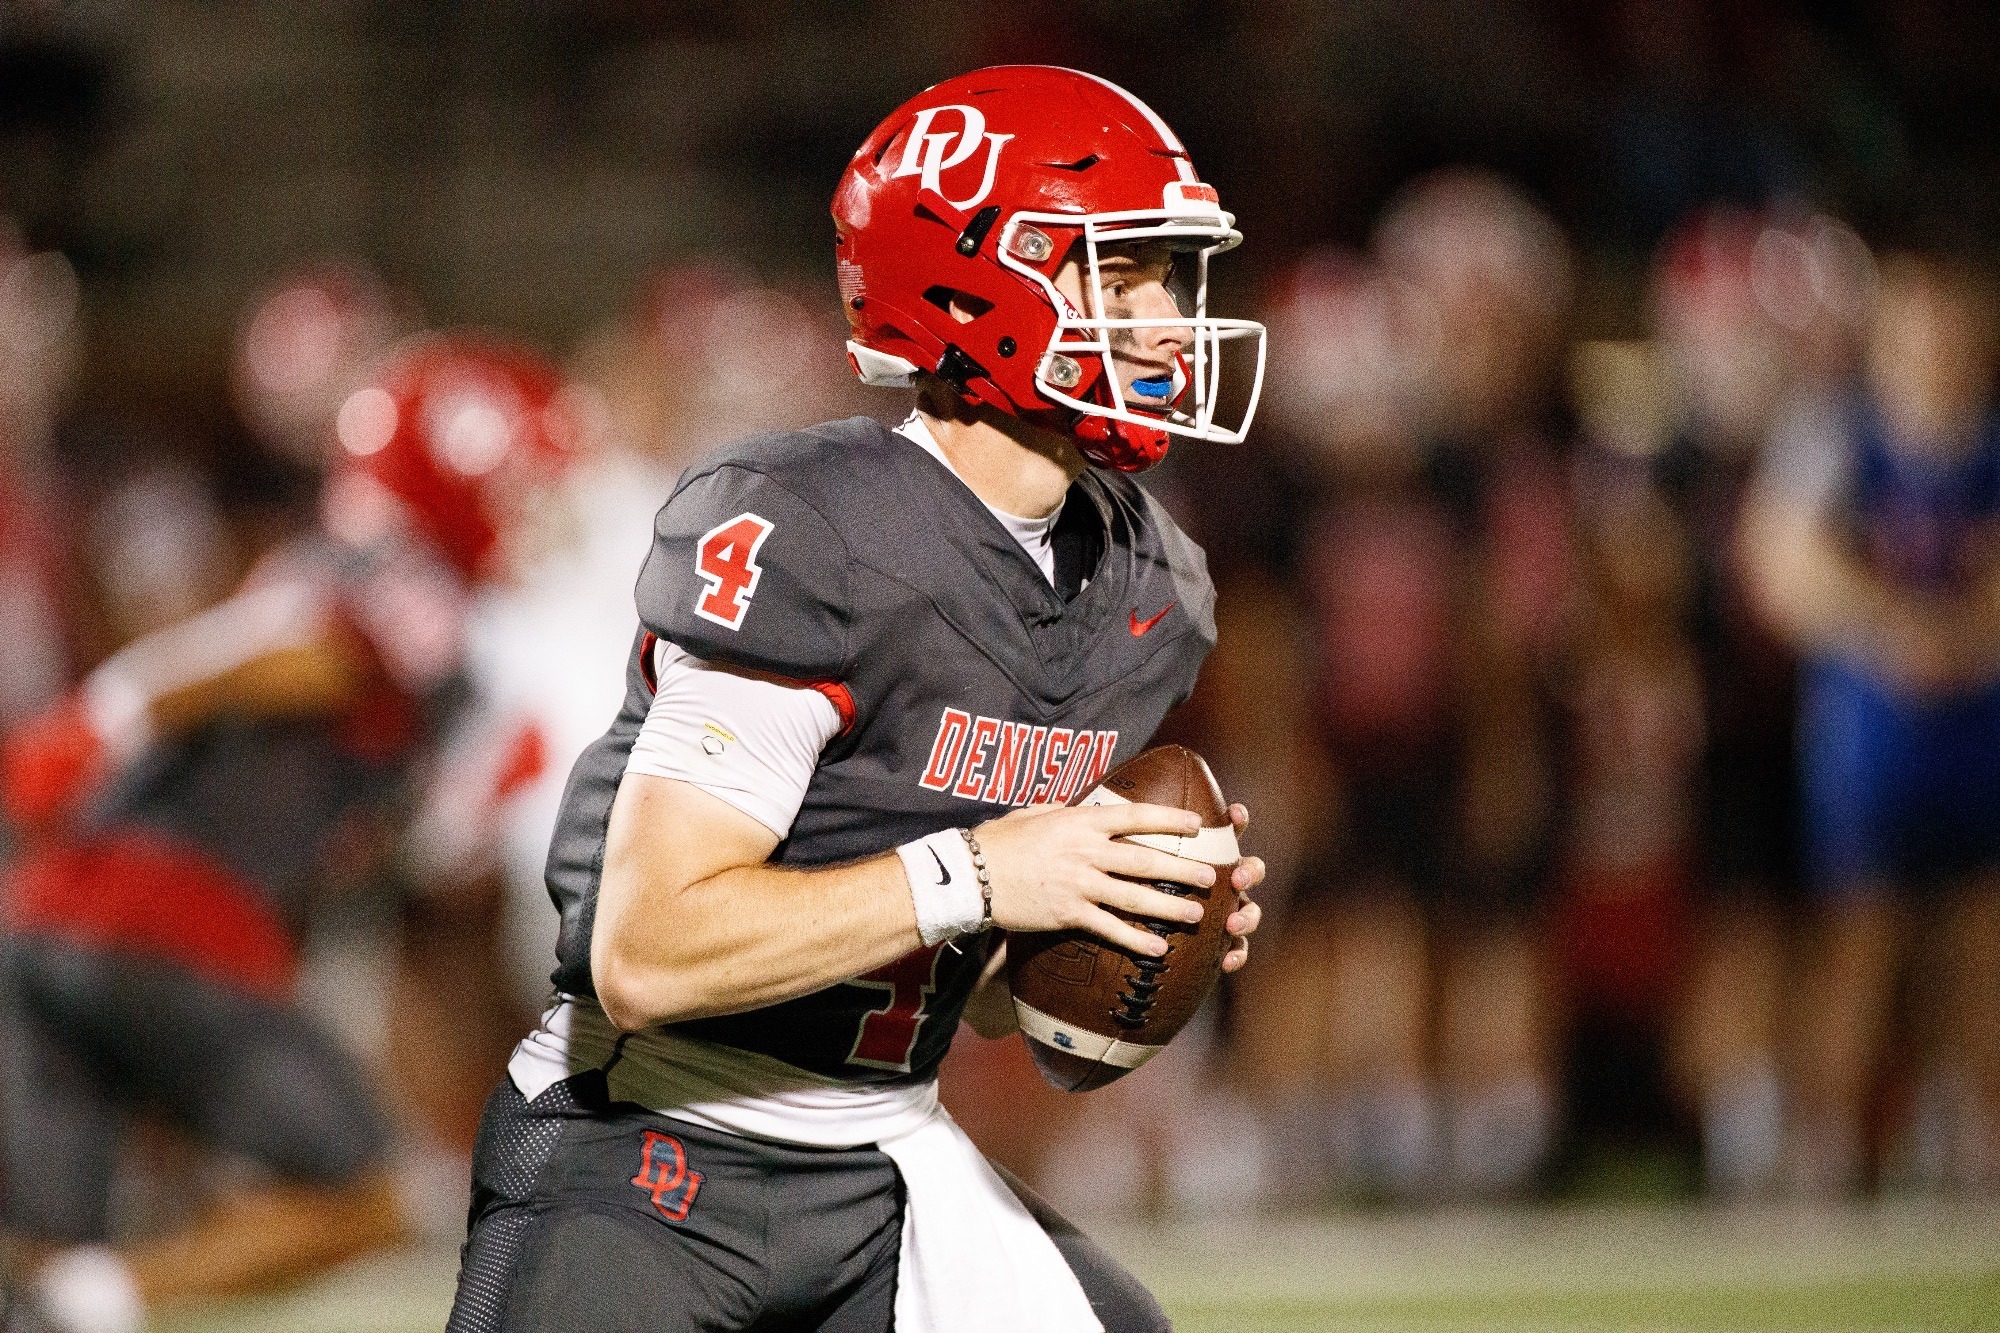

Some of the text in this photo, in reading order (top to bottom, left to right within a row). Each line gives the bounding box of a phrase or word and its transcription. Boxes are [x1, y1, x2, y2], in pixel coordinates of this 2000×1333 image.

[891, 104, 1015, 211] DU
[694, 512, 775, 631] 4
[918, 706, 1119, 807] DENISON
[629, 1127, 707, 1223] DU
